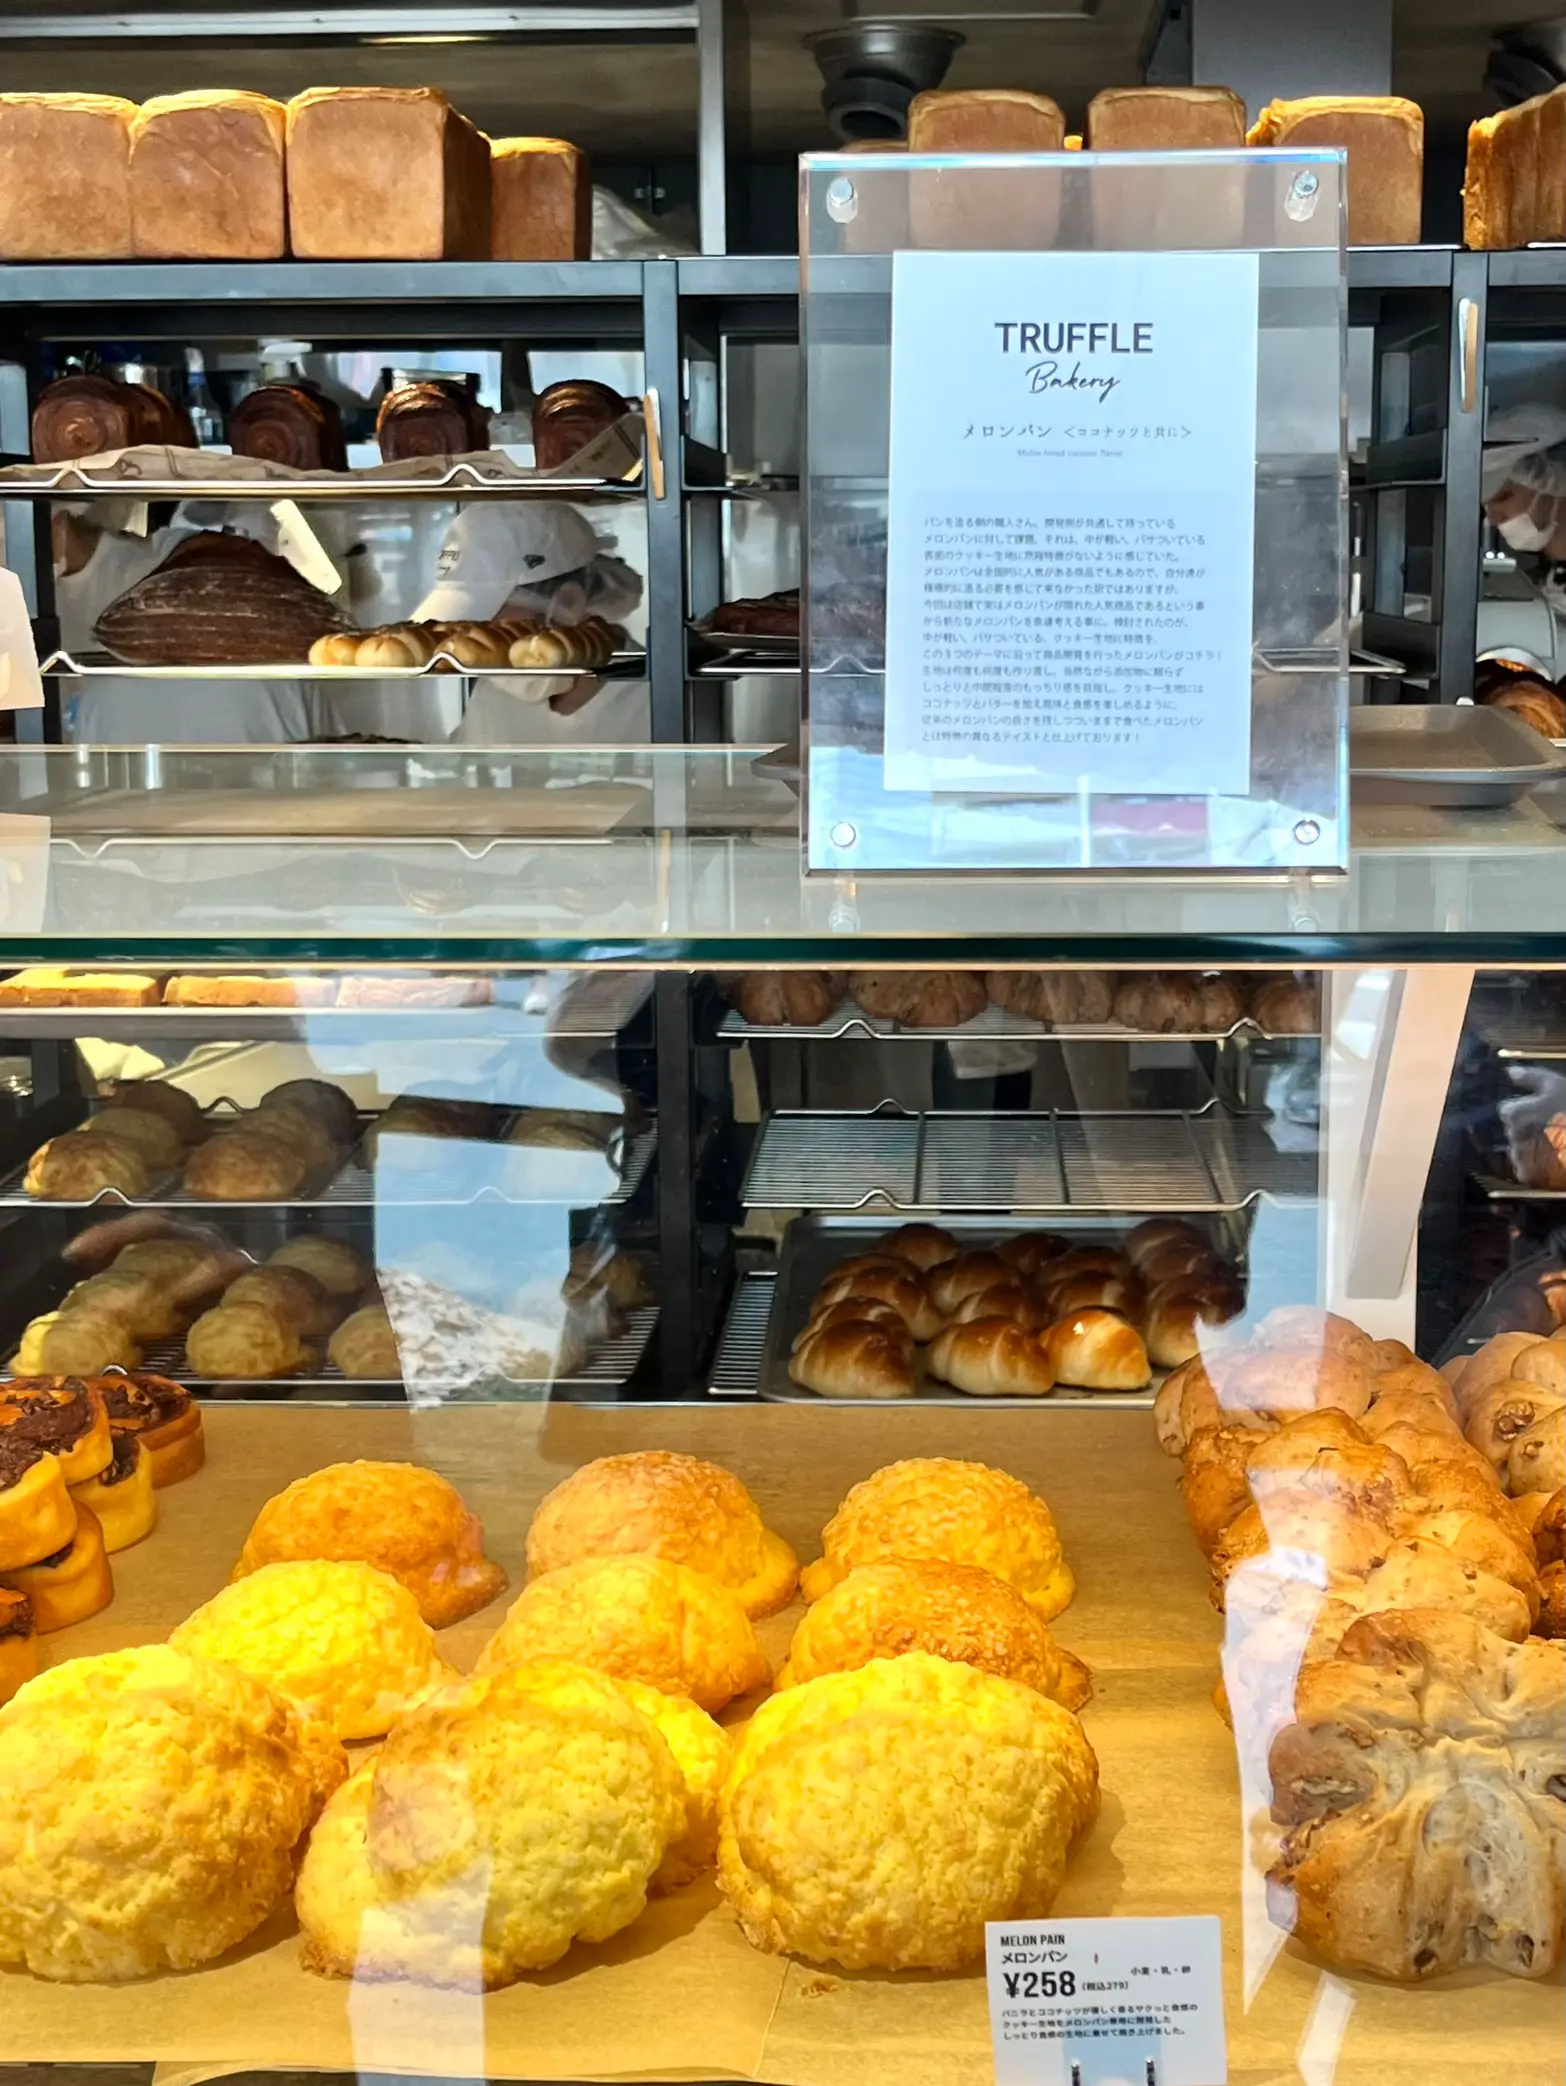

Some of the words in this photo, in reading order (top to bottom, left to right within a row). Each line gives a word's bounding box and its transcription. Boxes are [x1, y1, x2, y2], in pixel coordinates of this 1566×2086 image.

[994, 322, 1154, 354] TRUFFLE
[1025, 360, 1121, 404] Bakery
[963, 423, 1053, 440] メロンパン
[1001, 1936, 1037, 1946] MELON
[1040, 1934, 1065, 1945] PAIN
[1002, 1950, 1068, 1965] メロンパン
[1003, 1970, 1076, 1999] ¥258
